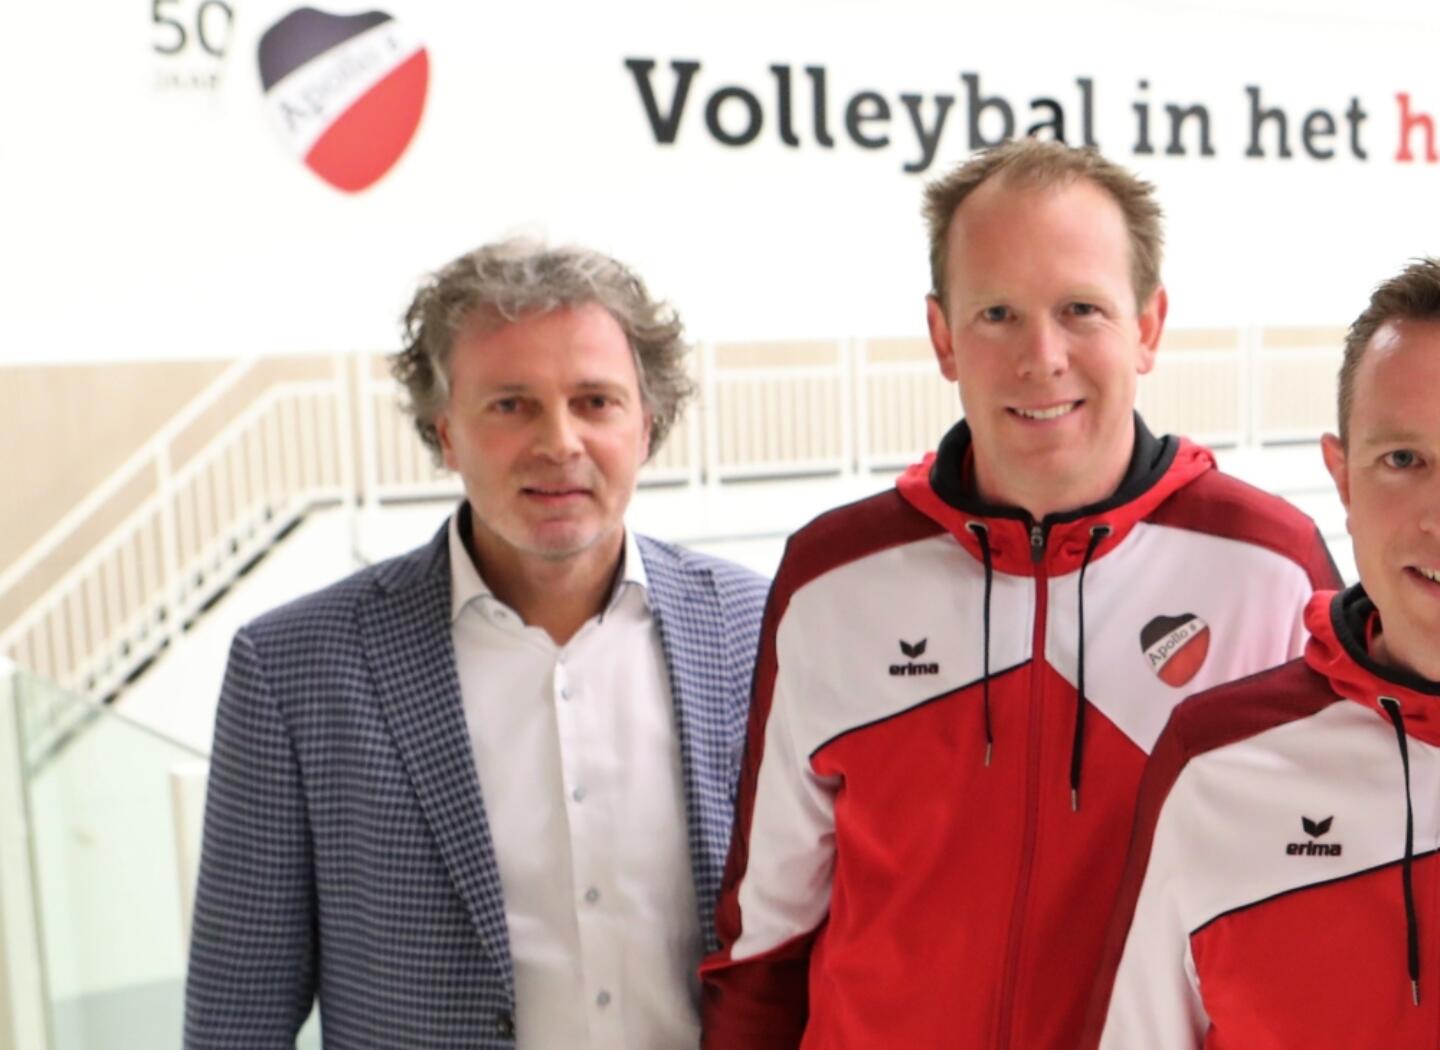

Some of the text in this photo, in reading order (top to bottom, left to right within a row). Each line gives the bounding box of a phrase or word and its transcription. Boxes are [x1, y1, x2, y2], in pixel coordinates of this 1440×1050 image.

[150, 0, 234, 58] 50
[624, 58, 1101, 173] Volleybal
[1132, 80, 1216, 158] in
[1244, 85, 1368, 161] het
[1148, 629, 1189, 667] Apollo
[889, 662, 939, 676] erima
[1286, 840, 1342, 856] erima
